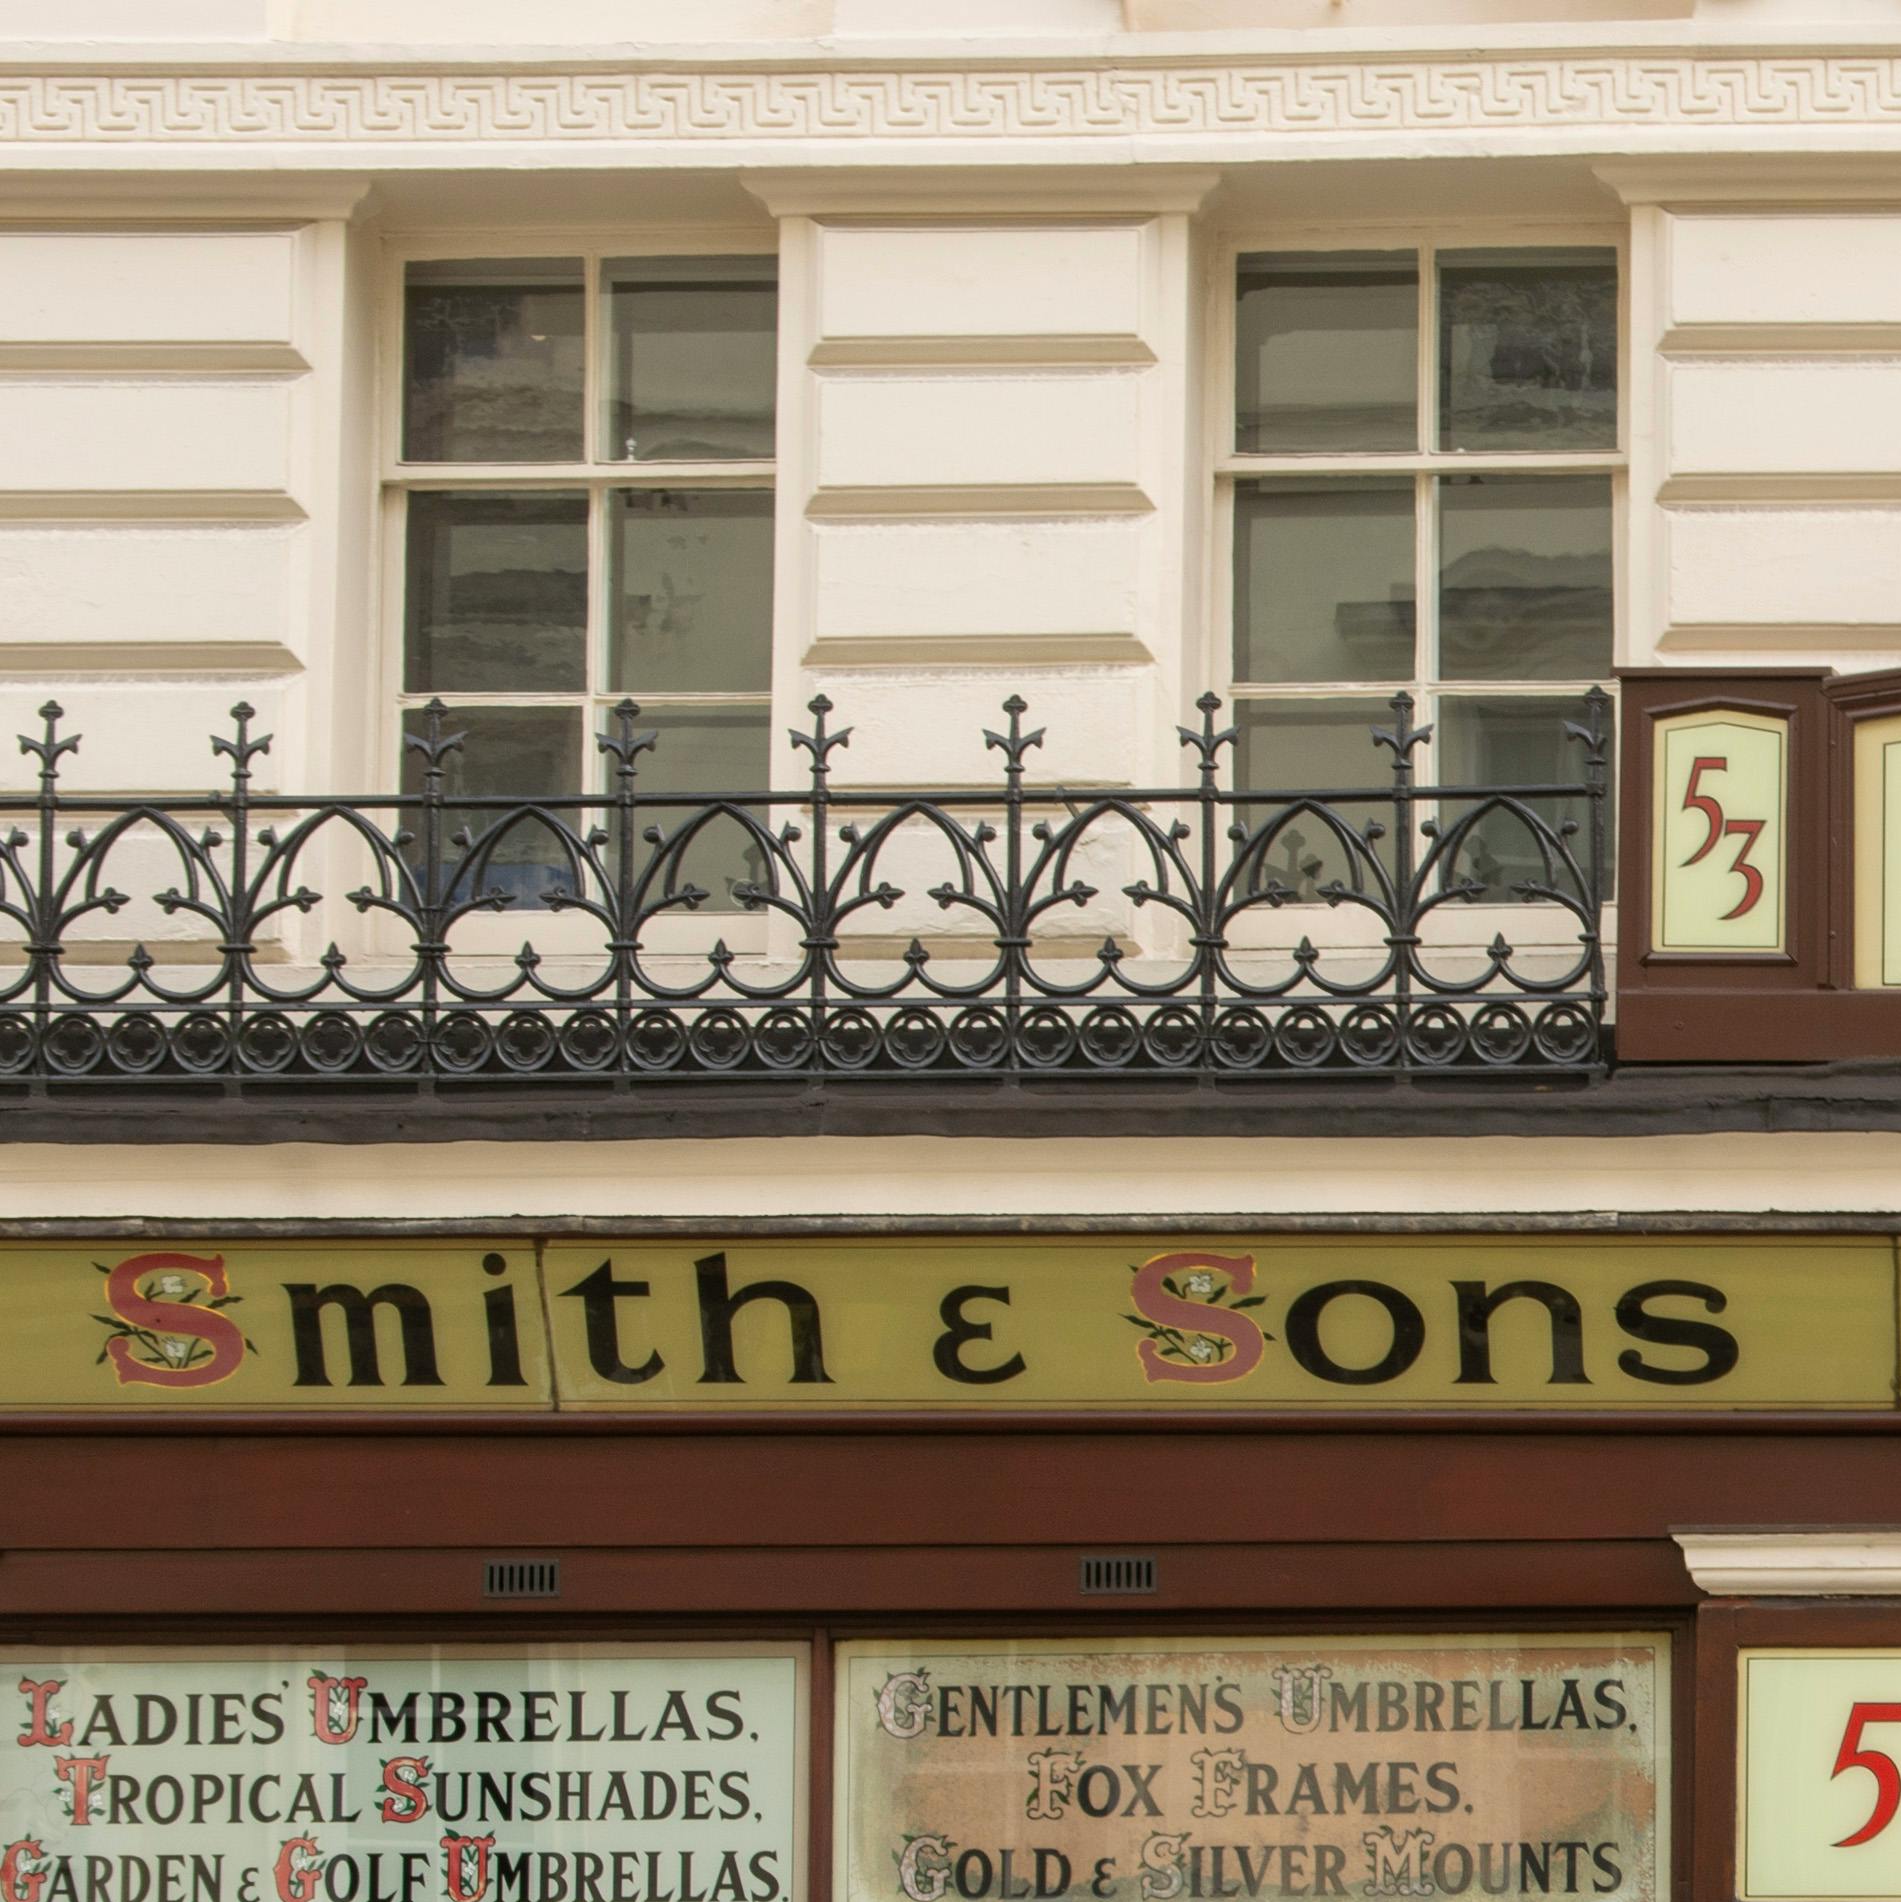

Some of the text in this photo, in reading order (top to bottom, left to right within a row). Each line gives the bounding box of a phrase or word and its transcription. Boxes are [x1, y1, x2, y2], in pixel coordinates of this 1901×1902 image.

[1680, 756, 1766, 922] 53
[100, 1252, 824, 1387] Smith
[1133, 1252, 1740, 1386] Sons
[53, 1753, 362, 1825] TROPICAL
[1026, 1749, 1164, 1822] FOX
[894, 1833, 1071, 1902] GOLD
[1141, 1830, 1347, 1900] SILVER
[1363, 1826, 1623, 1899] MOUNTS
